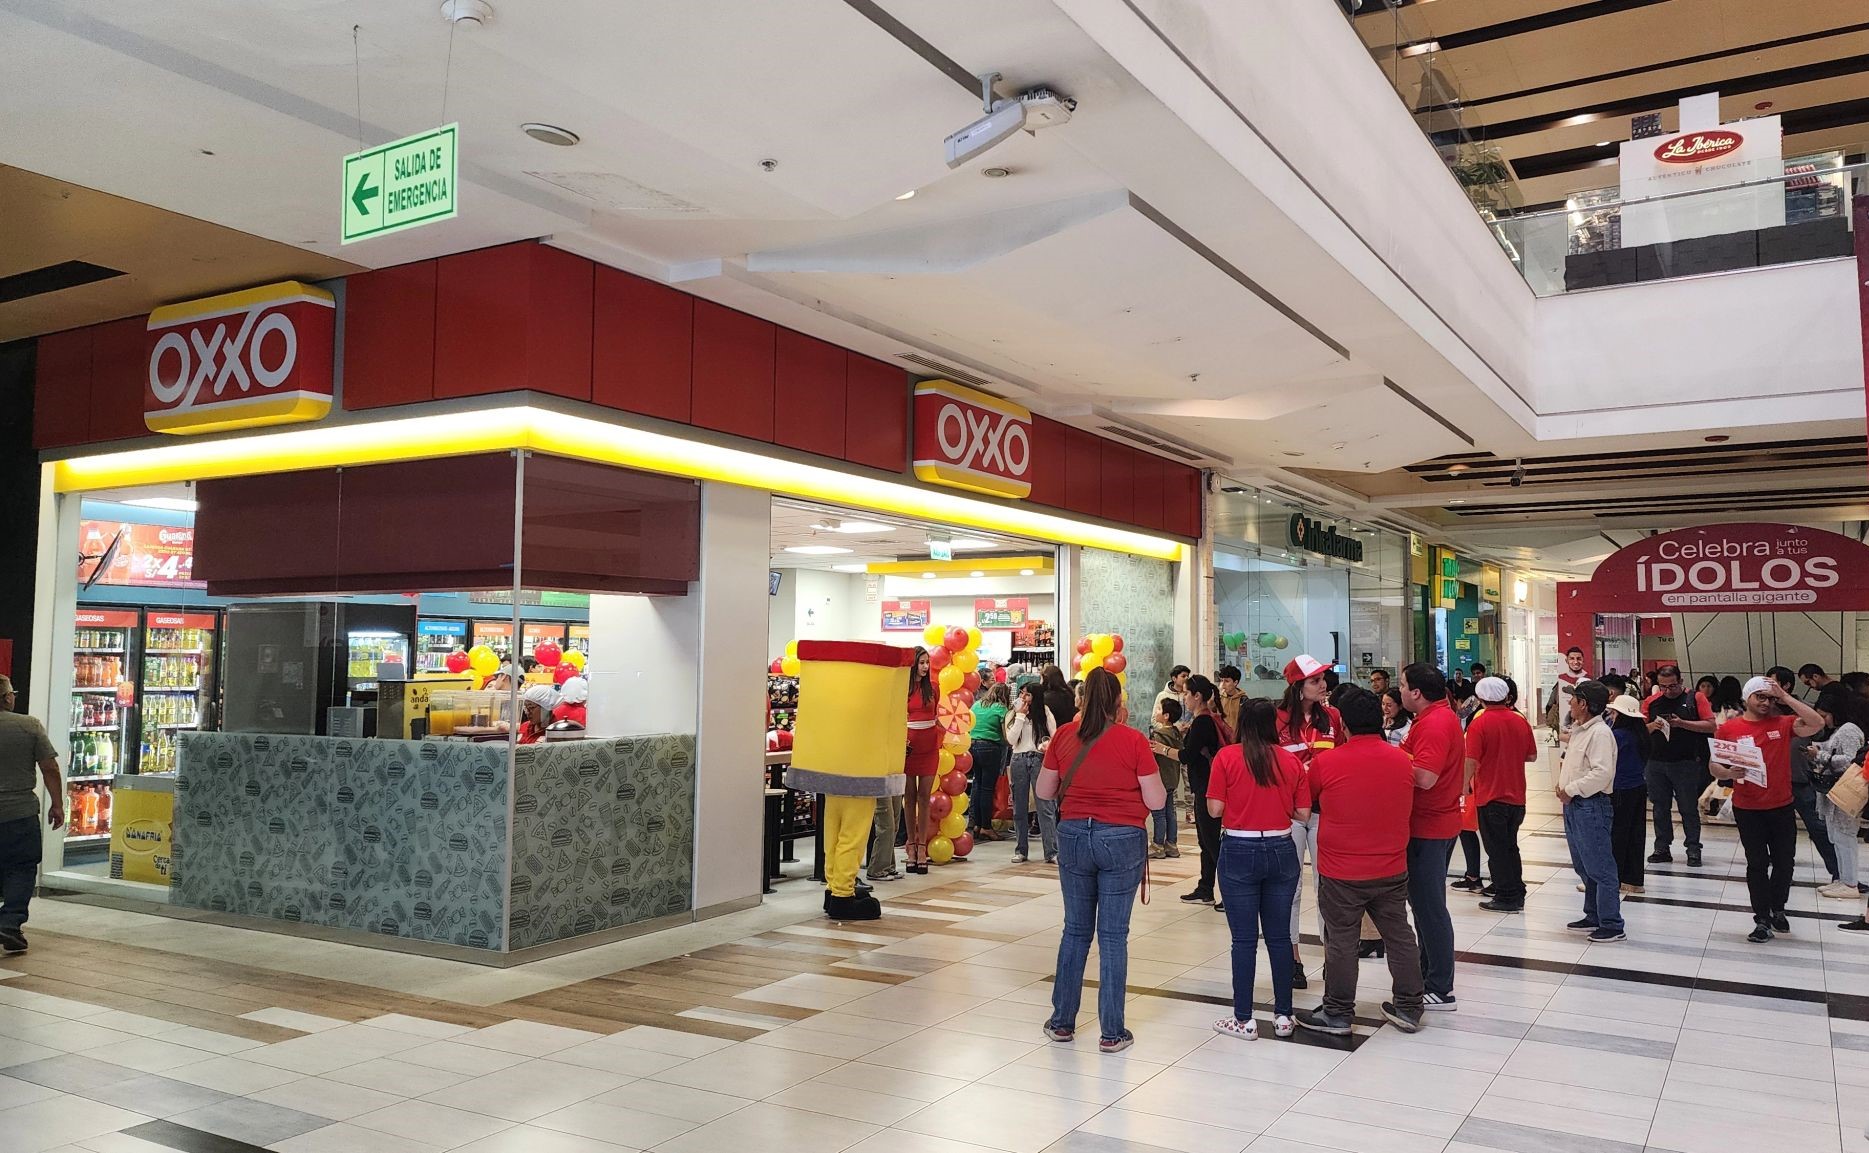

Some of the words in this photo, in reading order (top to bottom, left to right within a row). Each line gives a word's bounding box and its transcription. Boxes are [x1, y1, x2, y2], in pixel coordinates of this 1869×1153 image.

[1662, 138, 1685, 158] La
[394, 151, 427, 181] SALIDA
[429, 147, 442, 172] DE
[1705, 160, 1752, 172] CHOCOLATE
[388, 177, 448, 214] EMERGENCIA
[150, 308, 297, 408] OXXO
[937, 403, 1030, 476] OXXO
[1659, 538, 1770, 560] Celebra
[1775, 538, 1808, 548] junto
[1776, 548, 1785, 556] a
[1787, 546, 1808, 555] tus
[1636, 555, 1840, 592] ÍDOLOS
[1667, 595, 1686, 604] en
[1689, 592, 1748, 605] pantalla
[1751, 591, 1810, 603] gigante
[152, 854, 170, 865] Cerca
